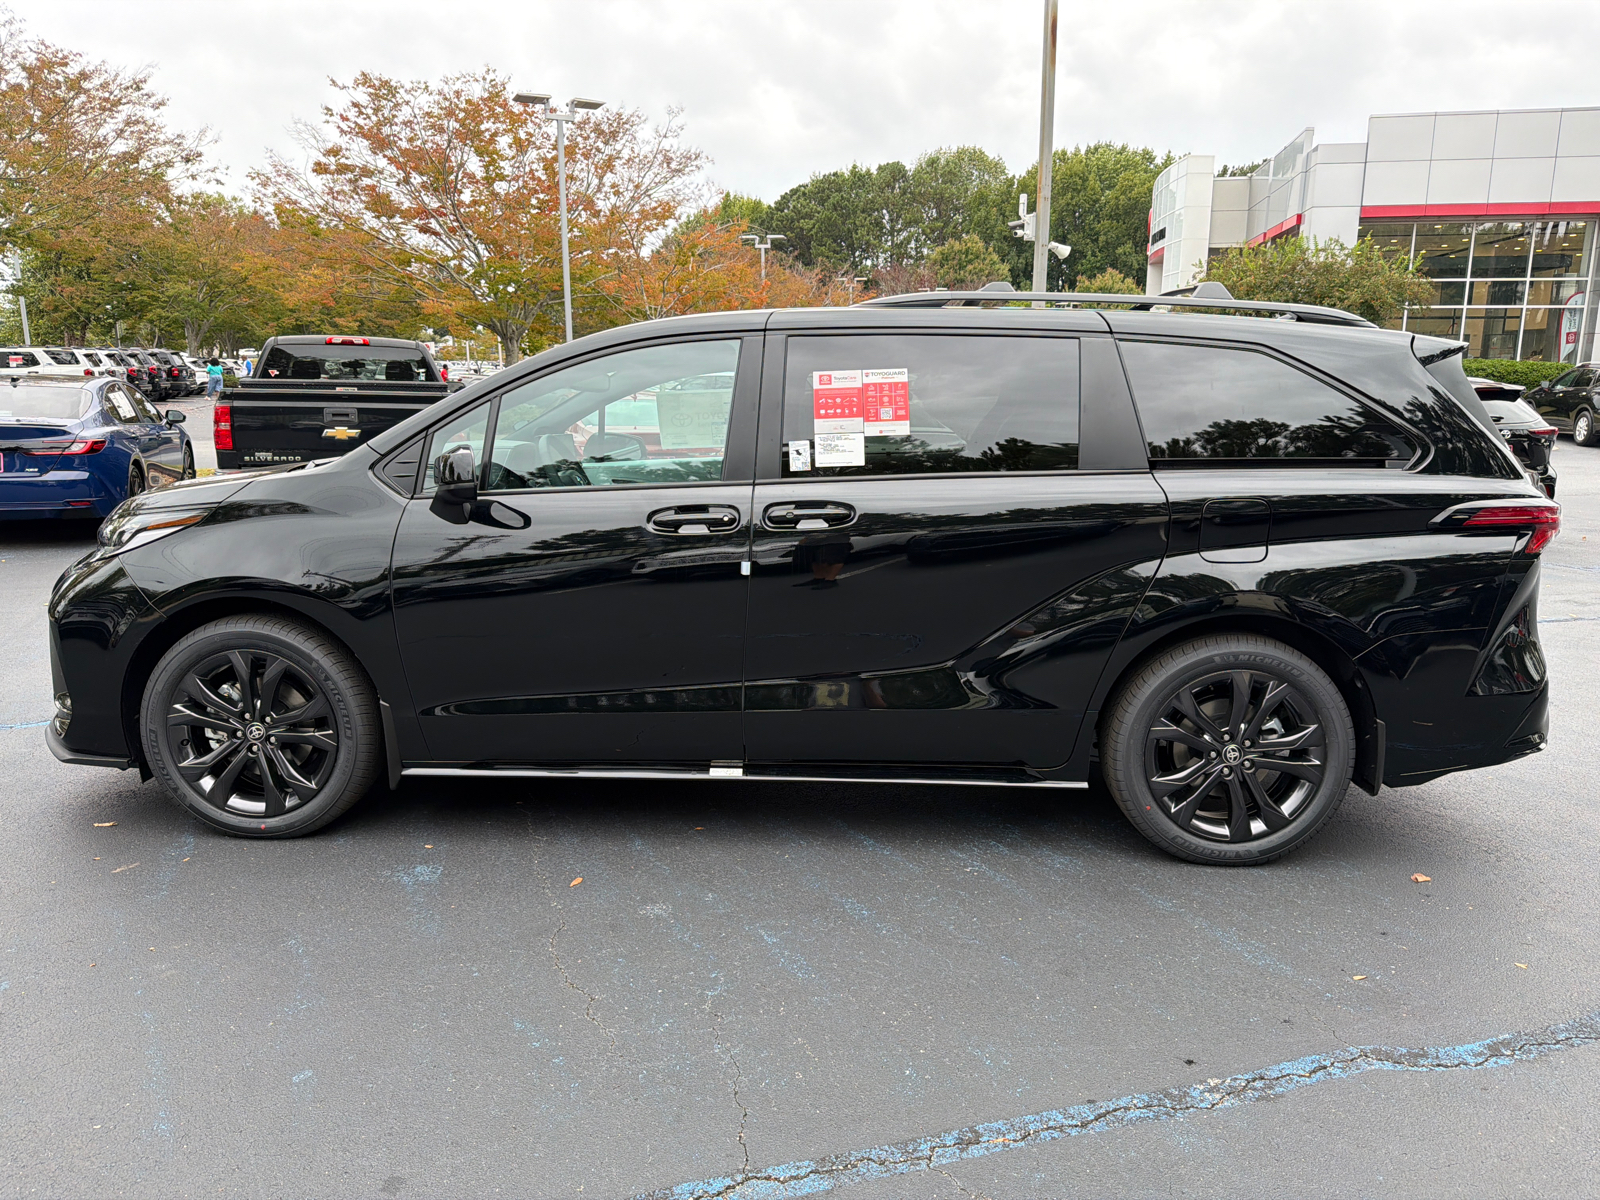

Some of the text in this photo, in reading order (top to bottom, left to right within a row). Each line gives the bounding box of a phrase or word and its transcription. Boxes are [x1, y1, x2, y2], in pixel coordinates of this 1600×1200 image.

[695, 411, 728, 420] TOYO
[1238, 654, 1302, 677] MICHELIN
[326, 680, 352, 739] MICHELIN
[149, 731, 177, 788] MICHELIN
[1174, 837, 1236, 858] MICHELIN
